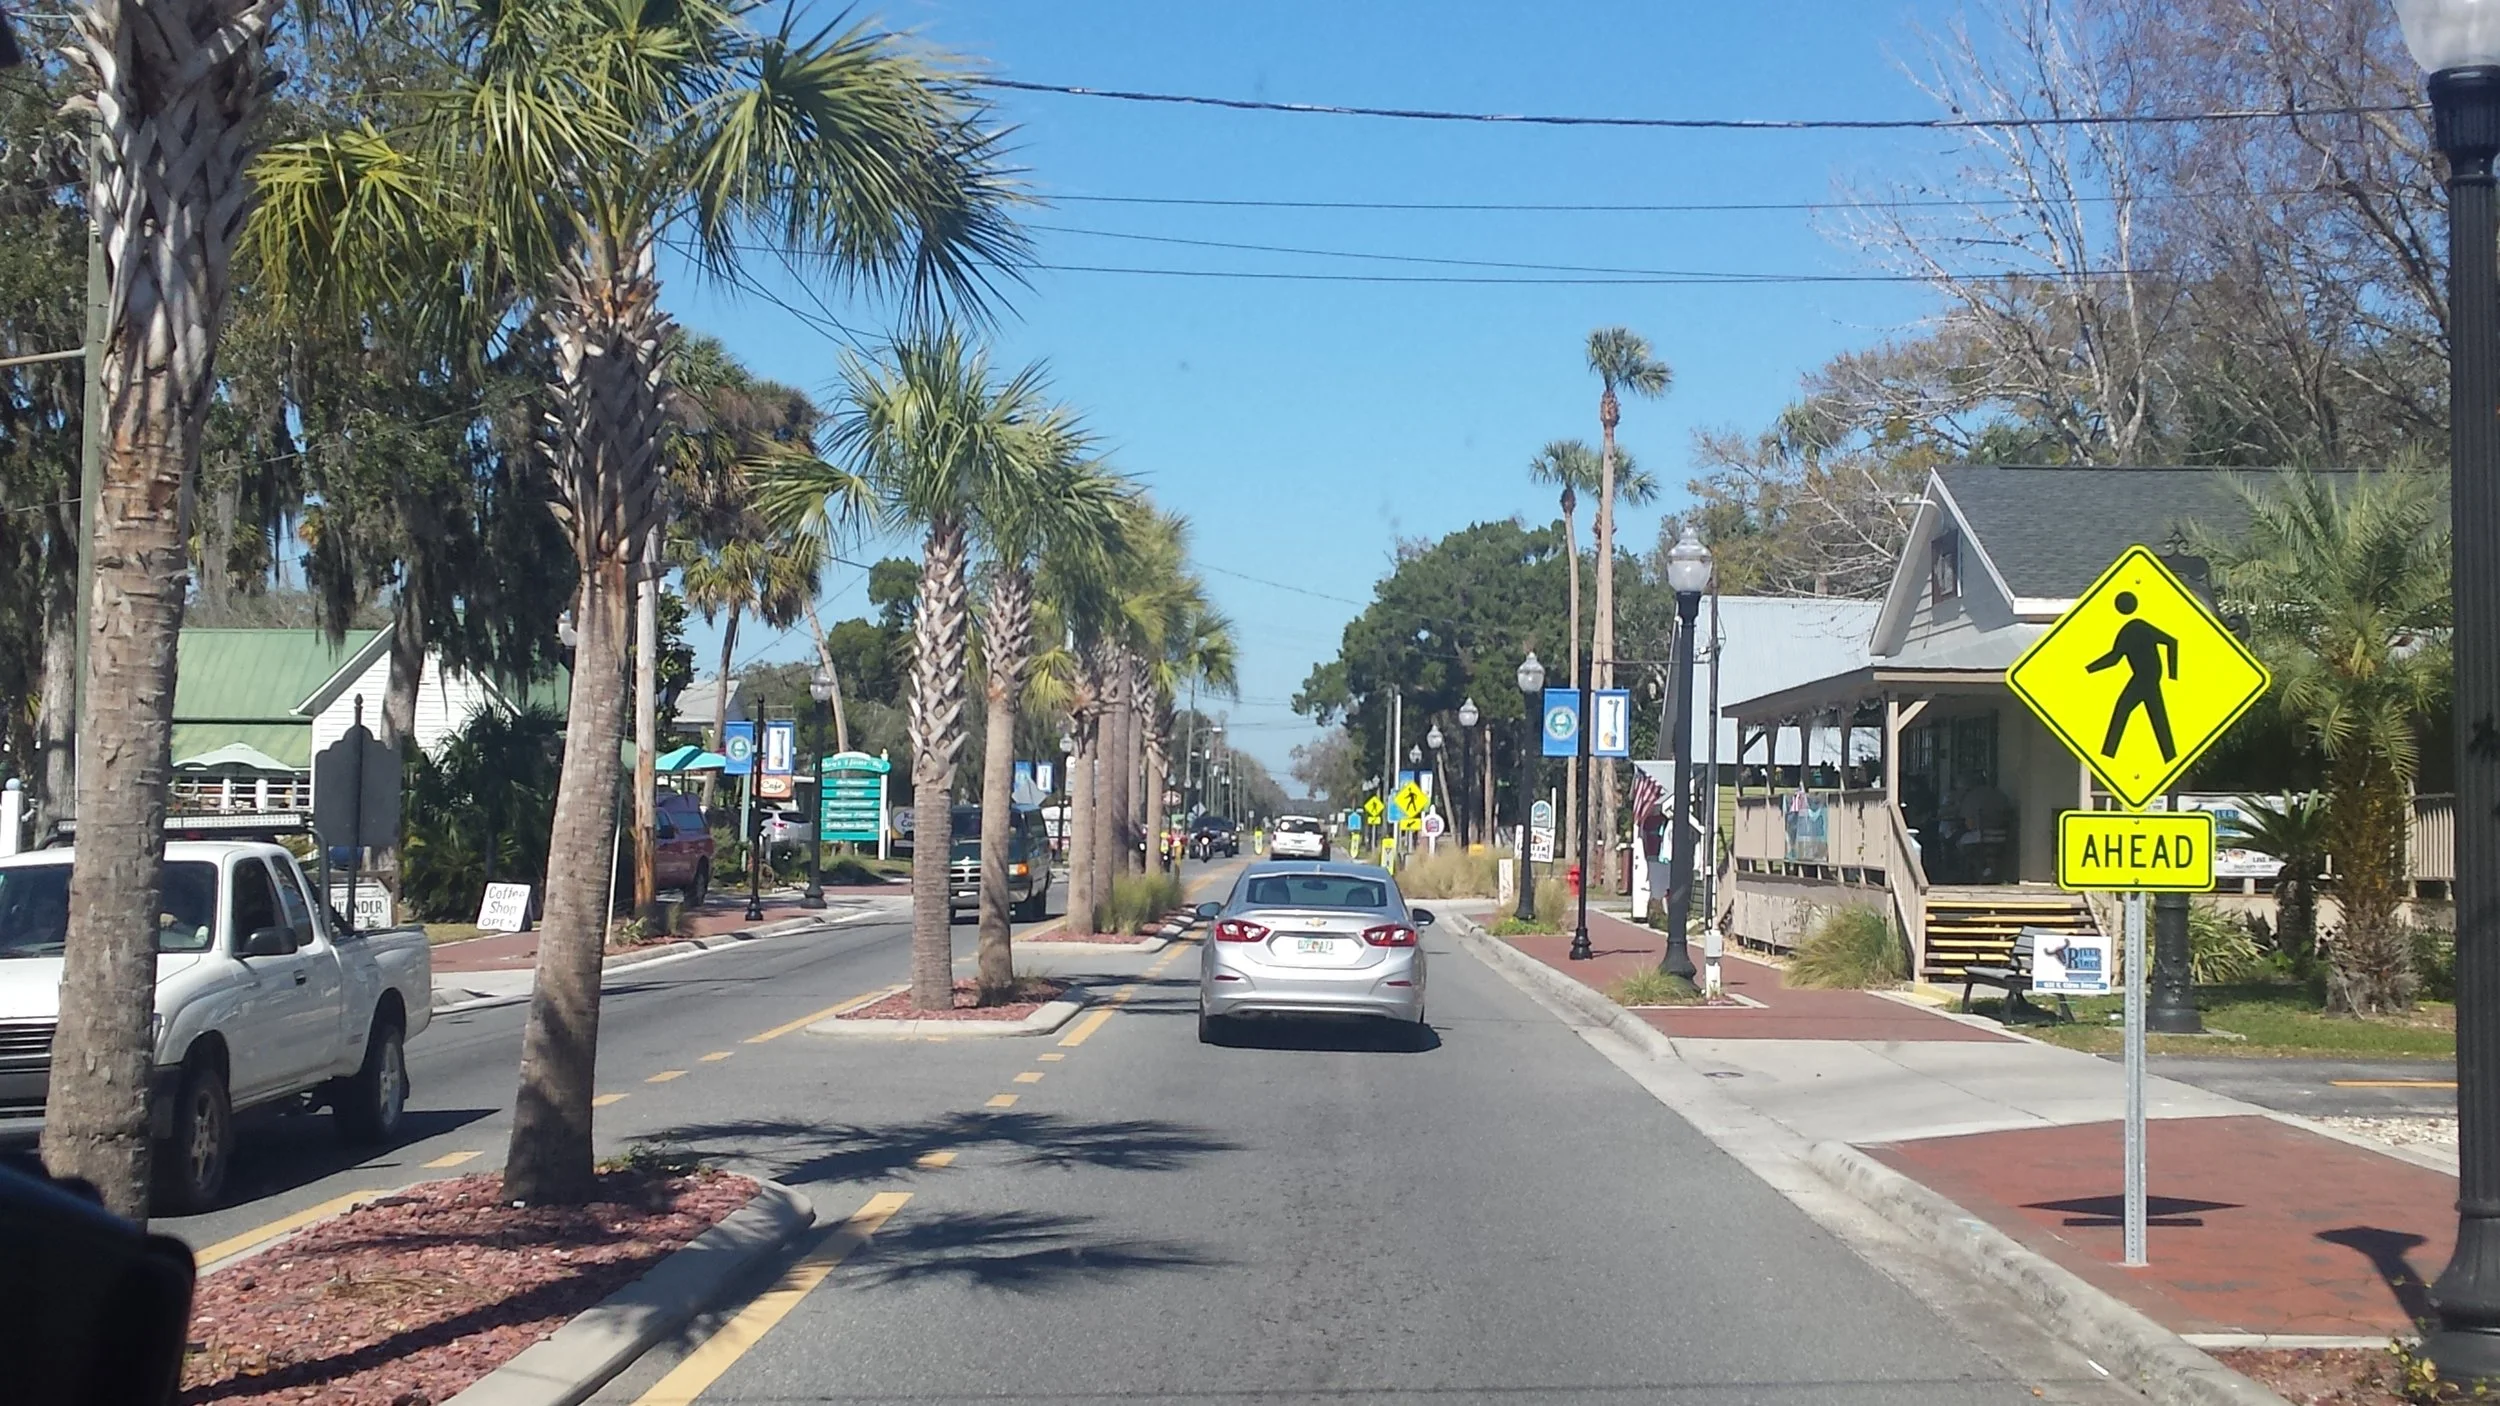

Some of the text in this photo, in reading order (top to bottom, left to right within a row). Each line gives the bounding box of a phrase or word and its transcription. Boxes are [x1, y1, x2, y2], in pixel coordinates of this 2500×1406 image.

[2081, 833, 2193, 869] AHEAD
[488, 886, 526, 900] Coffee
[489, 900, 517, 916] Shop
